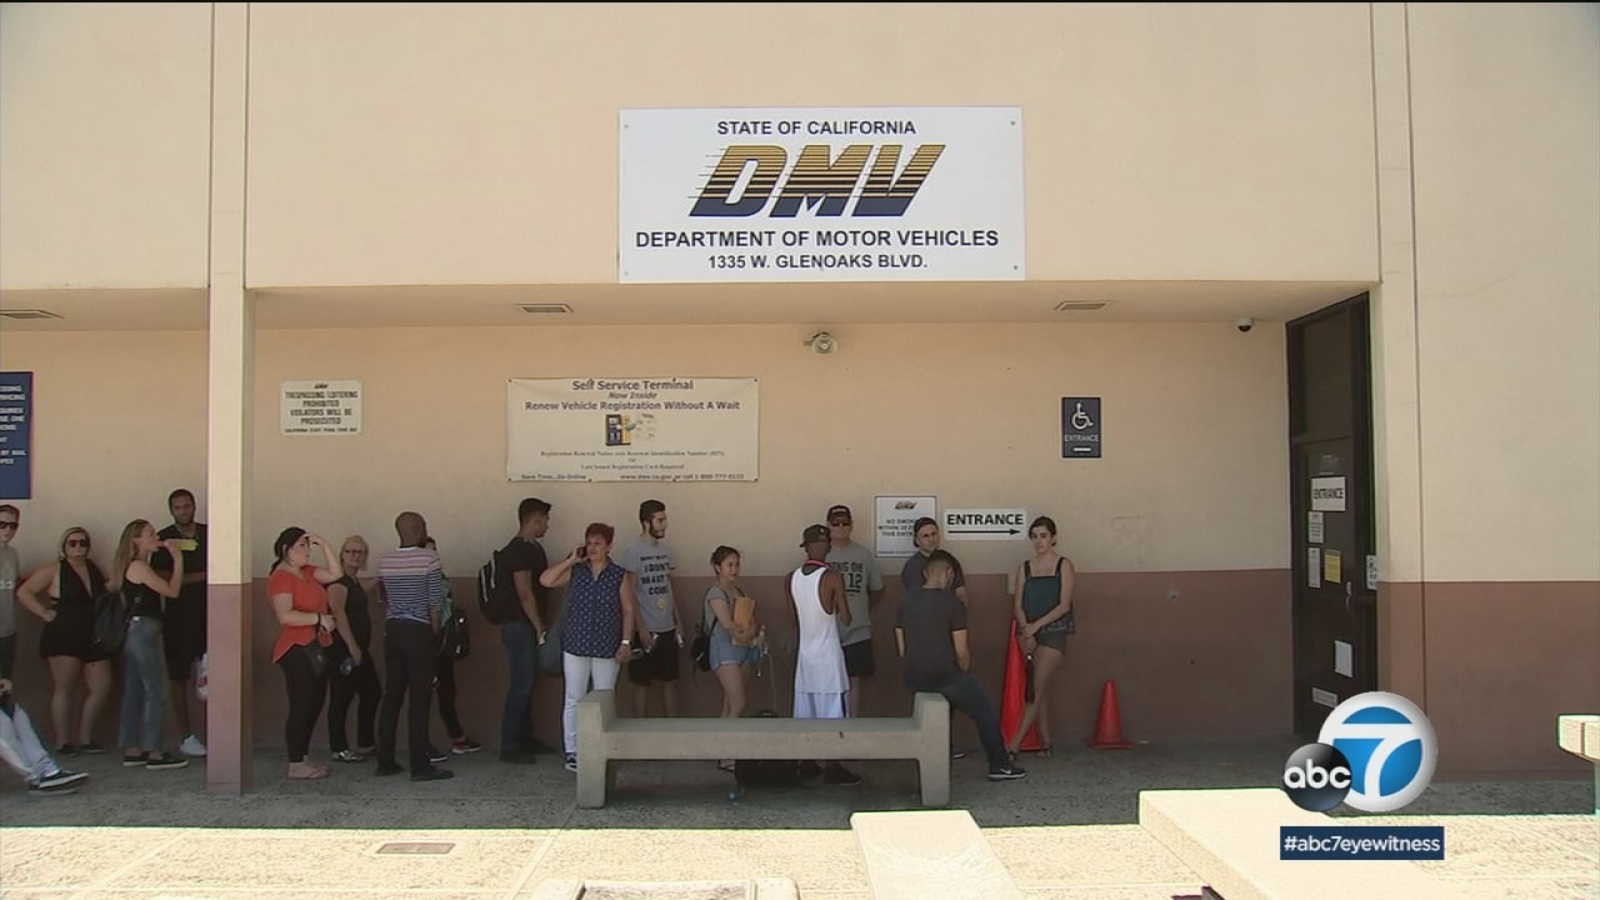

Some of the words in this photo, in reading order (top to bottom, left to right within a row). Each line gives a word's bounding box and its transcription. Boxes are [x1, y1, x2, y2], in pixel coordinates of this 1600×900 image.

[717, 121, 772, 134] STATE
[778, 121, 801, 134] OF
[807, 121, 916, 135] CALIFORNIA
[688, 144, 946, 219] DMV
[635, 231, 776, 247] DEPARTMENT
[782, 231, 810, 246] OF
[816, 231, 891, 246] MOTOR
[897, 230, 999, 246] VEHICLES
[708, 255, 746, 268] 1335
[750, 255, 770, 268] W.
[776, 254, 873, 268] GLENOAKS
[878, 254, 927, 268] BLVD.
[573, 380, 594, 390] Self
[598, 380, 640, 390] Service
[643, 380, 693, 390] Terminal
[525, 402, 559, 411] Renew
[561, 402, 598, 411] Vehicle
[600, 402, 661, 412] Registration
[664, 401, 704, 411] Without
[706, 402, 715, 410] A
[717, 401, 740, 410] Wait
[1065, 434, 1099, 442] ENTRANCE
[947, 514, 1024, 526] ENTRANCE
